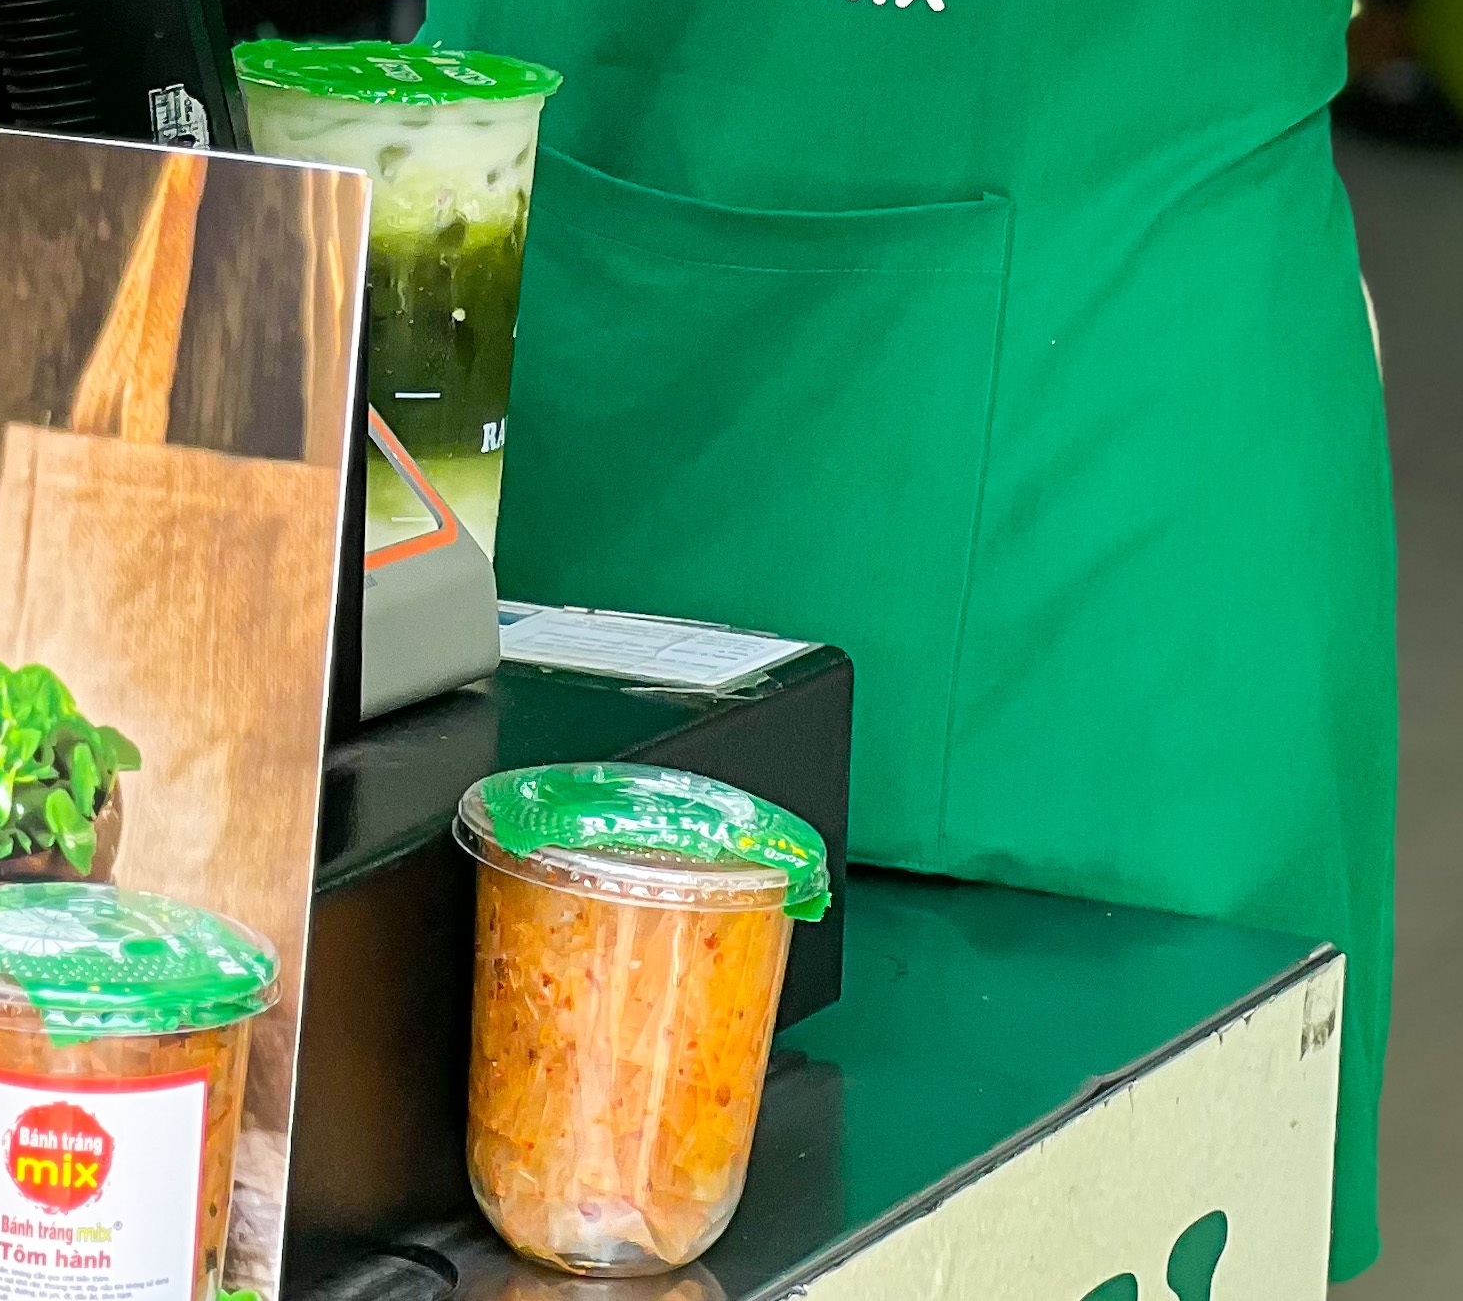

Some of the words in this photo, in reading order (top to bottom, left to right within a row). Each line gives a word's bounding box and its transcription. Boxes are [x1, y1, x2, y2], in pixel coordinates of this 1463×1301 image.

[480, 417, 506, 453] RA
[19, 1126, 58, 1150] Bánh
[62, 1132, 103, 1156] tráng
[16, 1153, 99, 1188] mix
[1, 1214, 33, 1238] Bánh
[39, 1221, 74, 1245] tráng
[0, 1240, 47, 1266] Tôm
[55, 1248, 112, 1269] hành
